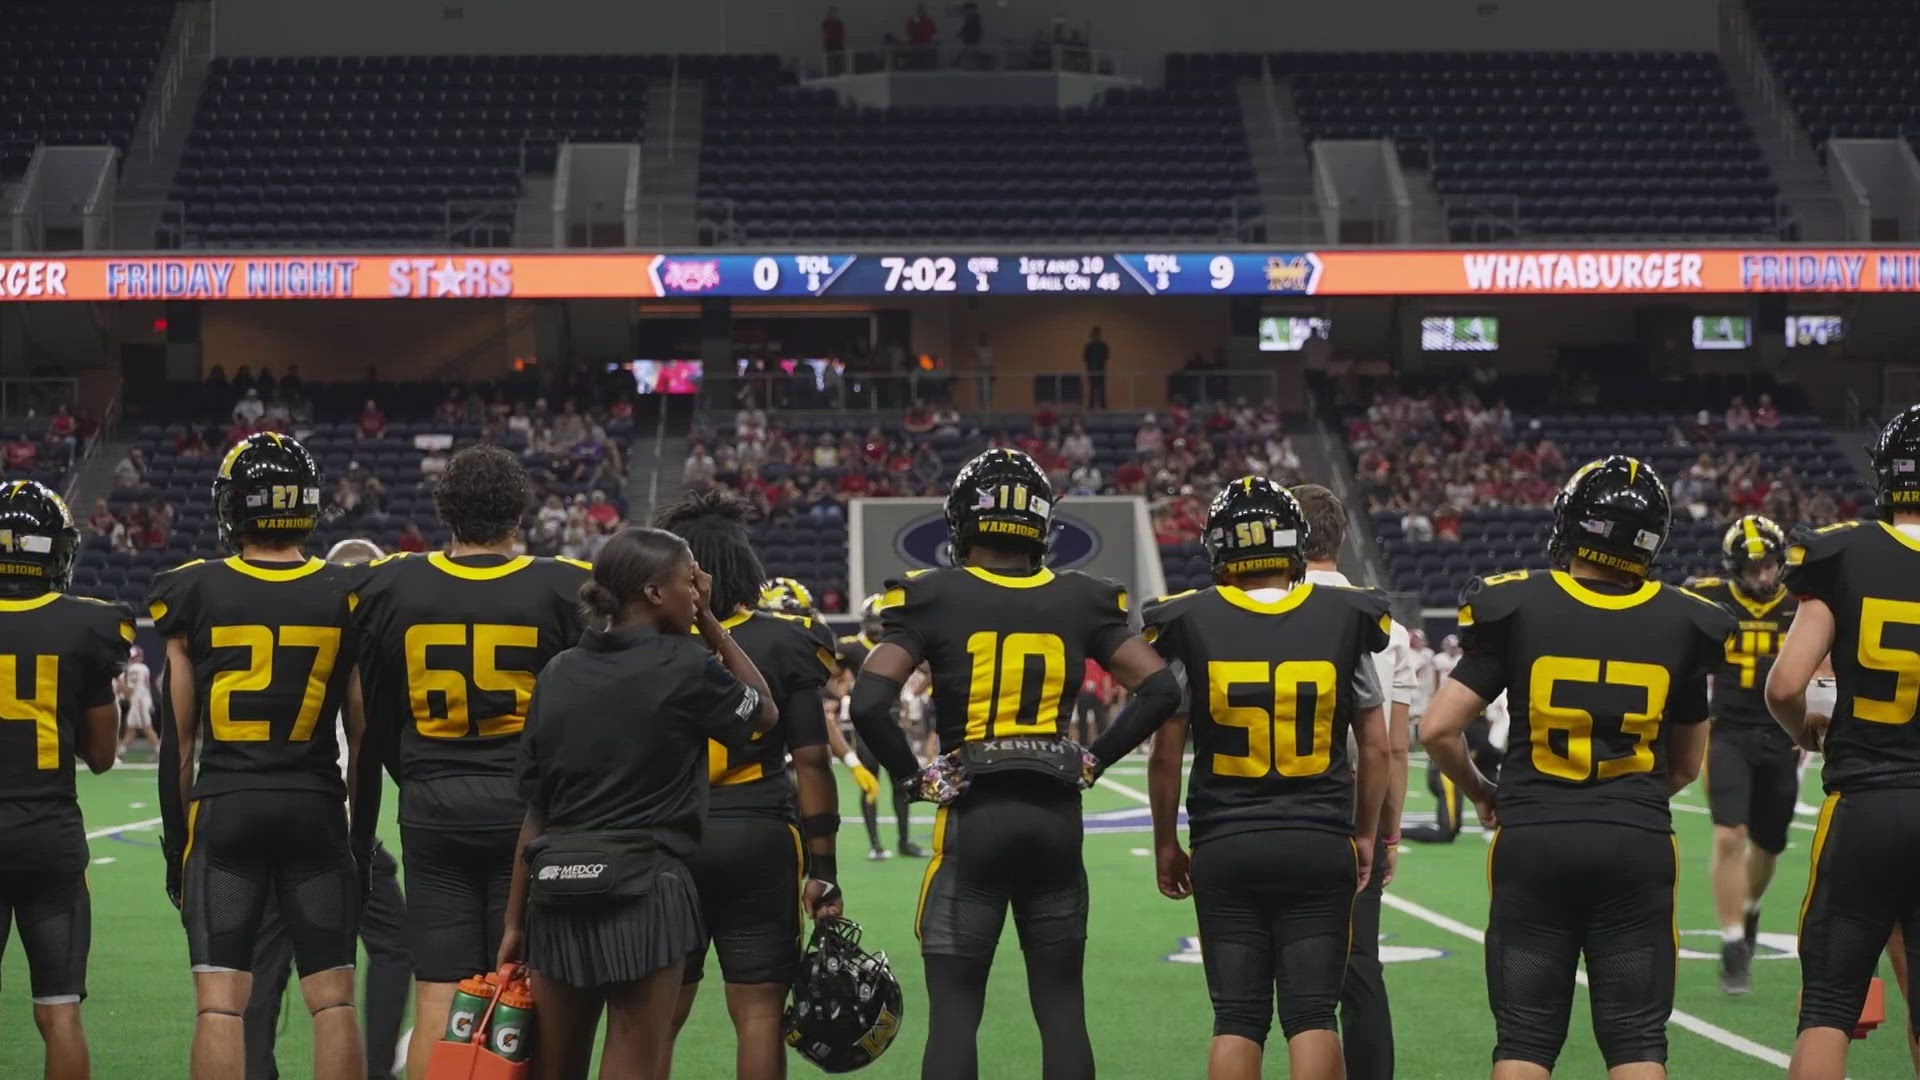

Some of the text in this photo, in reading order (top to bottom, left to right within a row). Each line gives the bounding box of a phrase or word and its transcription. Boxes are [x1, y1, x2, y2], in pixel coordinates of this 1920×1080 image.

[753, 257, 779, 291] 0
[796, 256, 833, 274] TOL
[881, 257, 956, 291] 7:02
[967, 257, 999, 274] QTR
[1081, 257, 1104, 274] 10
[1144, 255, 1181, 273] TOL
[1209, 256, 1235, 290] 9
[1463, 253, 1702, 291] WHATABURGER
[1740, 254, 1920, 290] FRIDAY NI
[0, 261, 68, 297] GER
[106, 262, 232, 297] FRIDAY
[247, 260, 357, 296] NIGHT
[976, 273, 990, 292] 1
[1064, 274, 1091, 291] ON
[272, 485, 298, 509] 27
[999, 485, 1027, 510] 10
[979, 521, 1040, 538] WARRIORS
[1235, 521, 1266, 548] 50
[1226, 557, 1289, 574] WARRIORS
[1853, 597, 1920, 724] 5
[210, 624, 342, 741] 27
[404, 623, 539, 738] 65
[964, 631, 1066, 741] 10
[0, 653, 60, 770] 4
[1208, 660, 1337, 778] 50
[1530, 656, 1670, 780] 63
[984, 740, 1064, 755] XENITH
[561, 864, 603, 875] MEDCO
[451, 1011, 474, 1038] G
[497, 1027, 520, 1053] G
